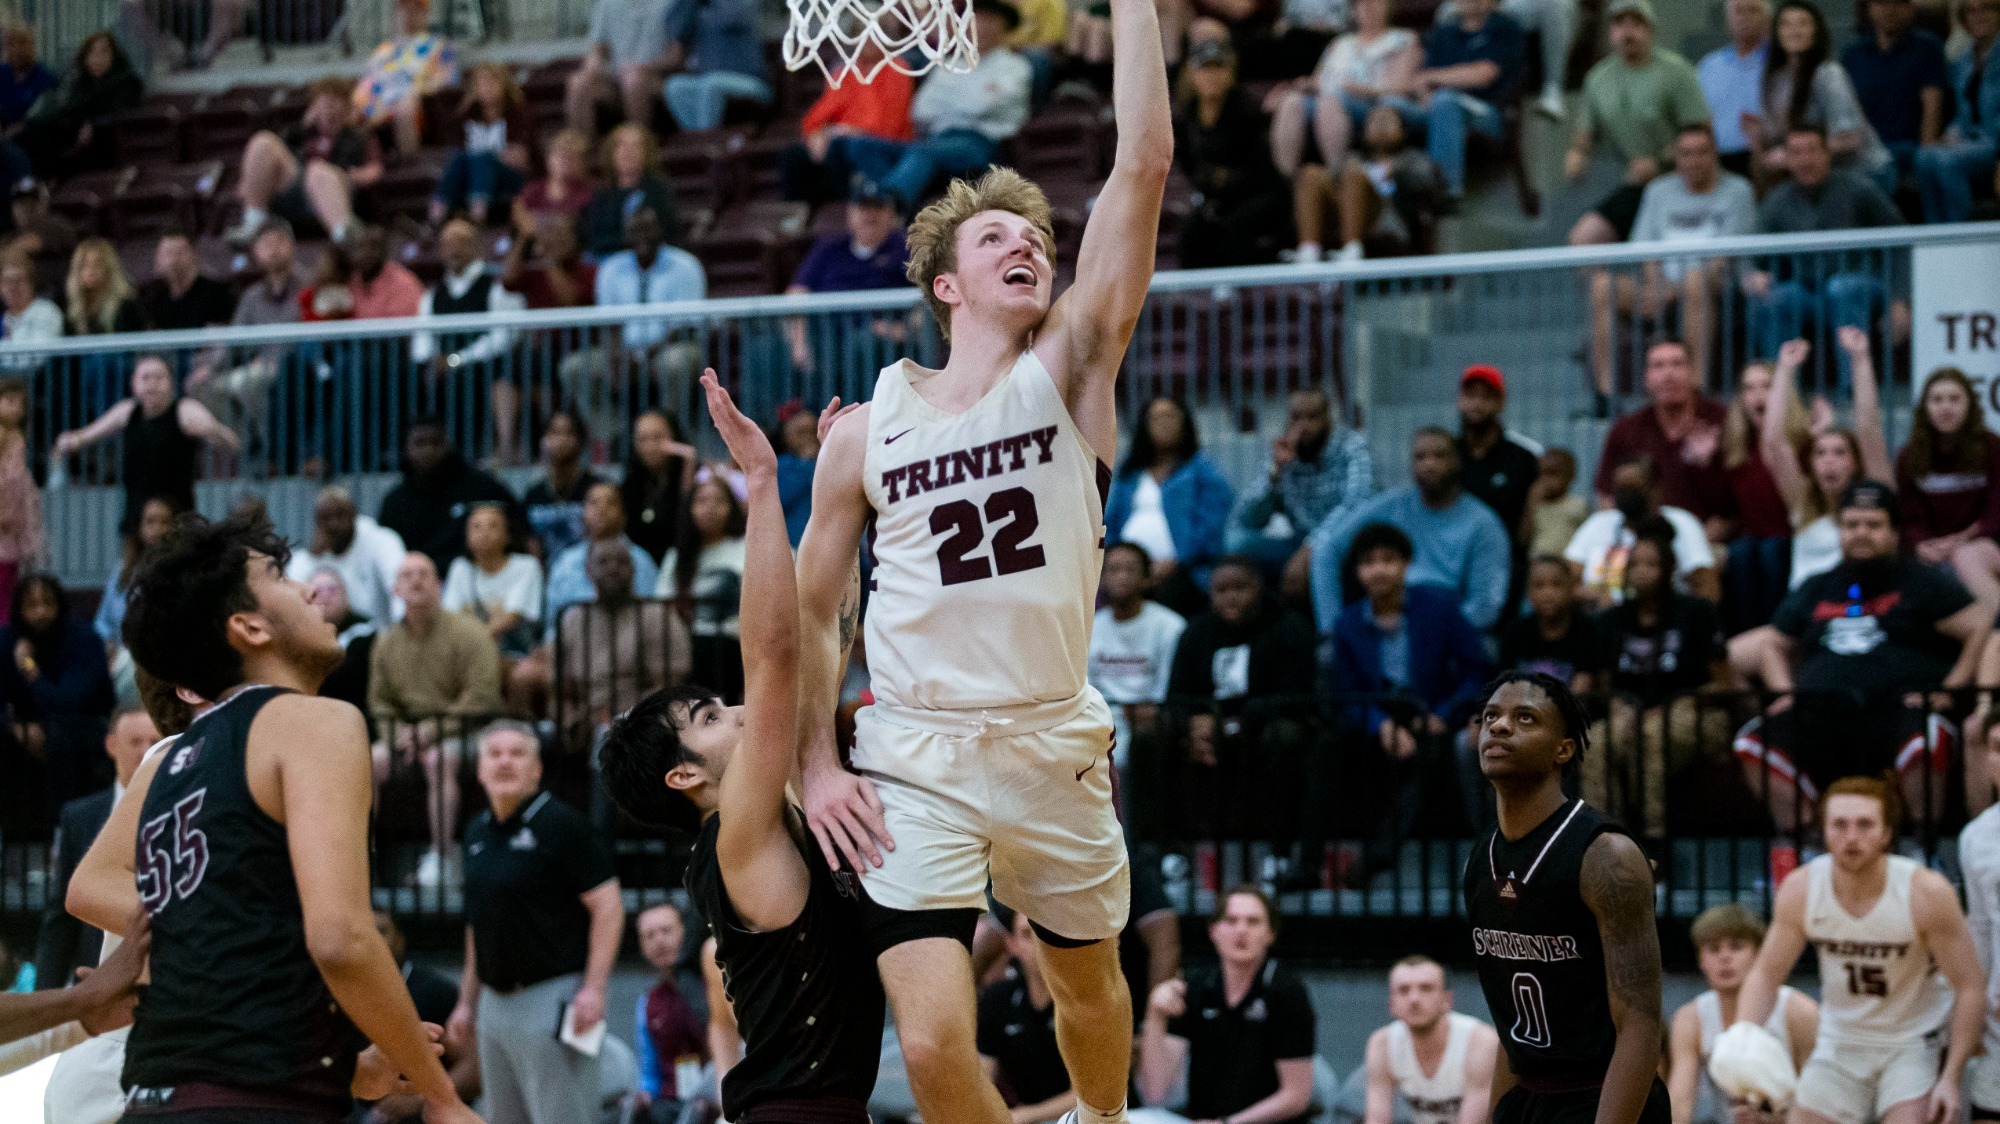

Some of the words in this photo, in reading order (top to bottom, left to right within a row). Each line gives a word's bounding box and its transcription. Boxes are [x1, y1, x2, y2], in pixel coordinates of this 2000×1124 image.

[881, 424, 1059, 505] TRINITY
[928, 486, 1047, 587] 22
[137, 786, 210, 918] 55
[1472, 928, 1583, 963] SCHREINER
[1844, 961, 1887, 997] 15
[1510, 972, 1551, 1048] 0
